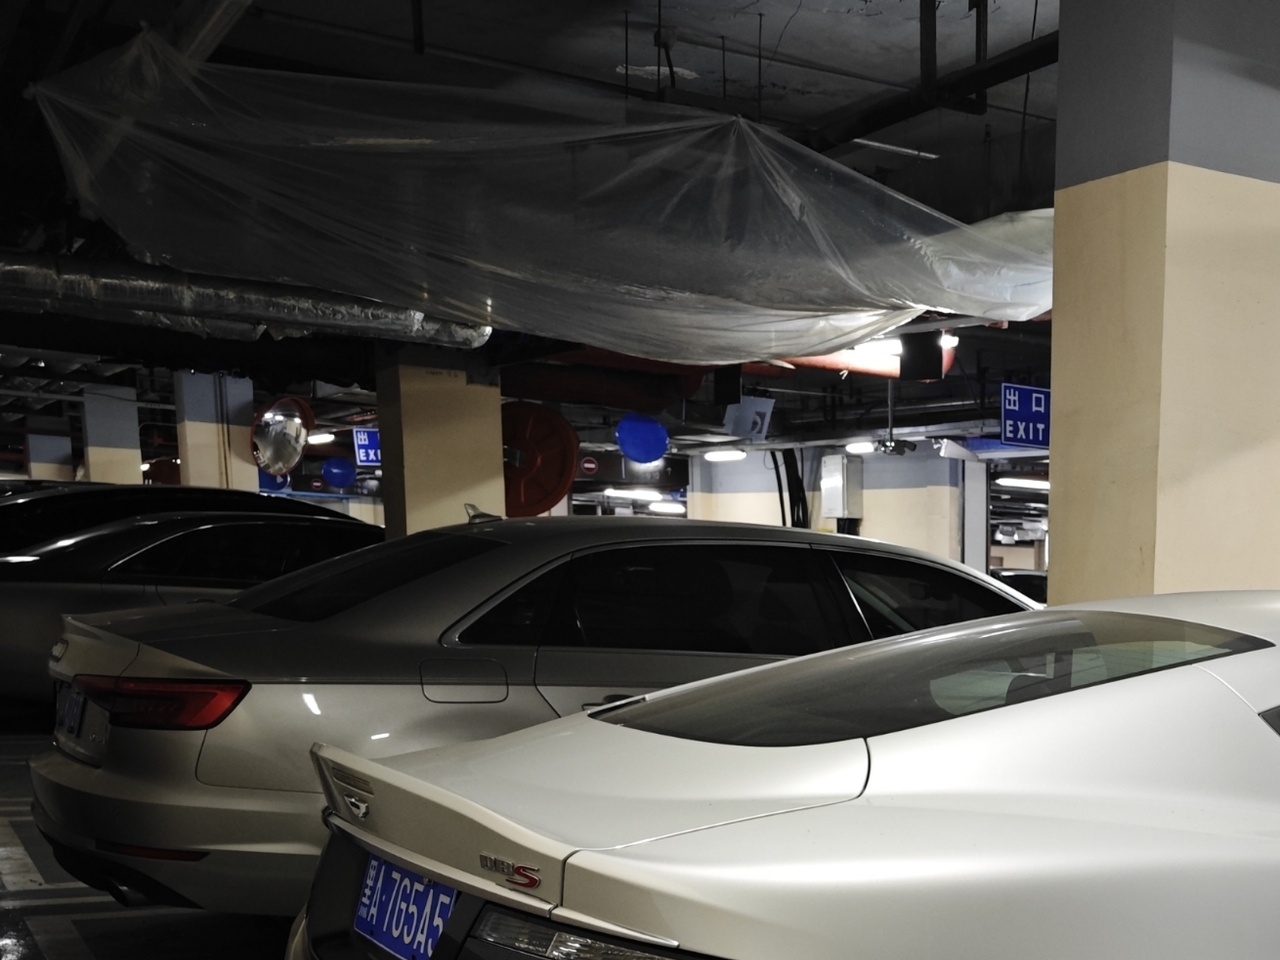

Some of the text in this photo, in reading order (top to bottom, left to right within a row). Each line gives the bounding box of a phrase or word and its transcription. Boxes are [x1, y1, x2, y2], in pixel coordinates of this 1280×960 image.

[1005, 389, 1045, 413] 出口
[1005, 420, 1045, 441] EXIT
[359, 449, 381, 461] EXI
